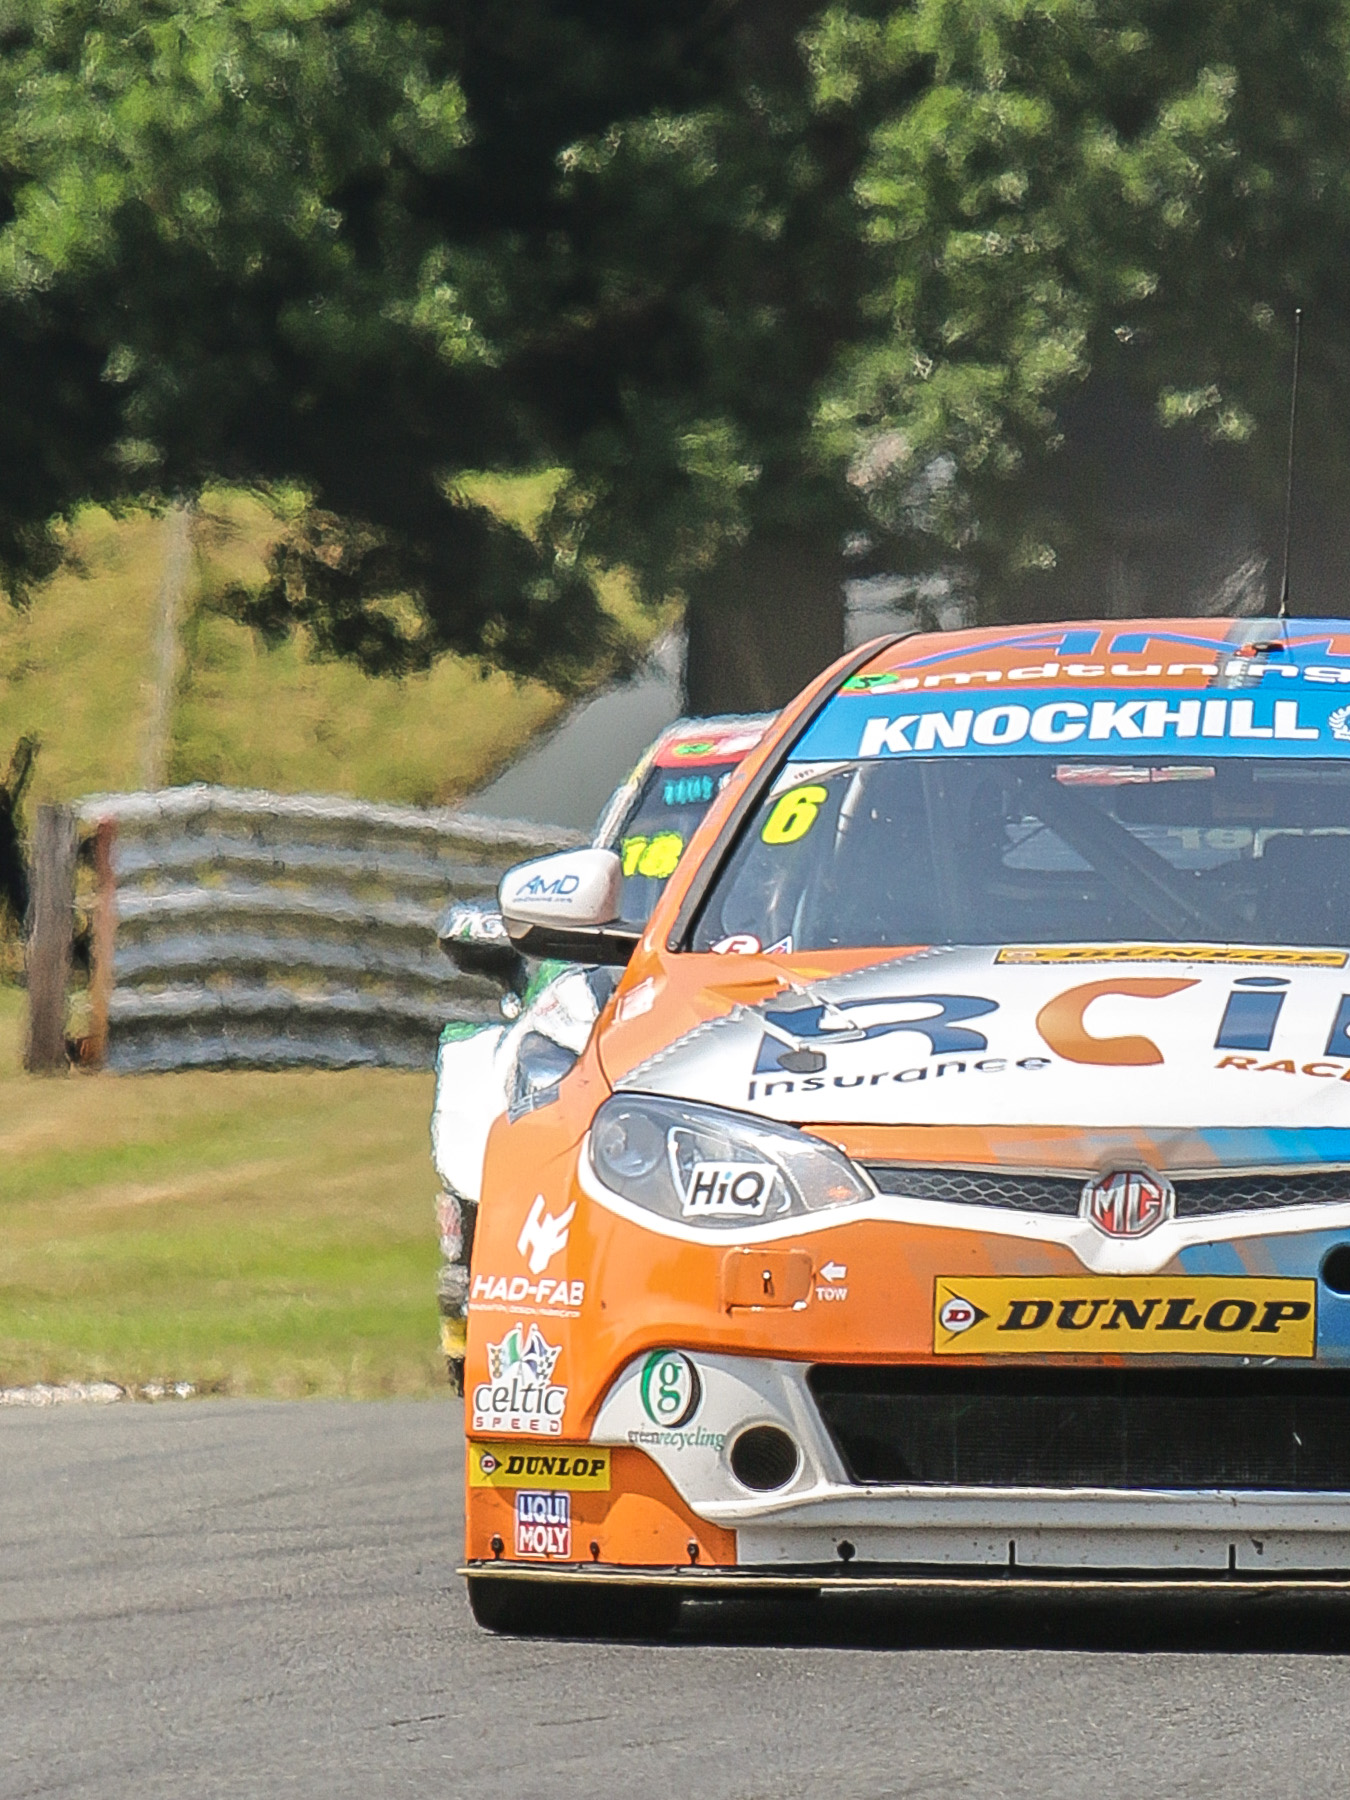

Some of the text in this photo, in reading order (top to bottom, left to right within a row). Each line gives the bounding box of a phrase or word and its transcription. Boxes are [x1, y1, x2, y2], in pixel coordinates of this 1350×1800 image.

[858, 699, 1320, 757] KNOCKHILL
[762, 786, 828, 844] 6
[515, 875, 580, 895] AMD
[747, 1056, 1052, 1101] Insurance
[690, 1171, 765, 1208] HiQ
[1094, 1173, 1161, 1233] MG
[471, 1274, 584, 1306] HAD-FAB
[815, 1287, 848, 1302] TOW
[996, 1298, 1311, 1333] DUNLOP
[476, 1378, 565, 1415] celtic
[657, 1362, 682, 1413] g
[475, 1416, 560, 1433] SPEED
[505, 1455, 605, 1476] DUNLOP
[519, 1496, 567, 1524] LIQUI
[519, 1525, 570, 1553] MOLY
